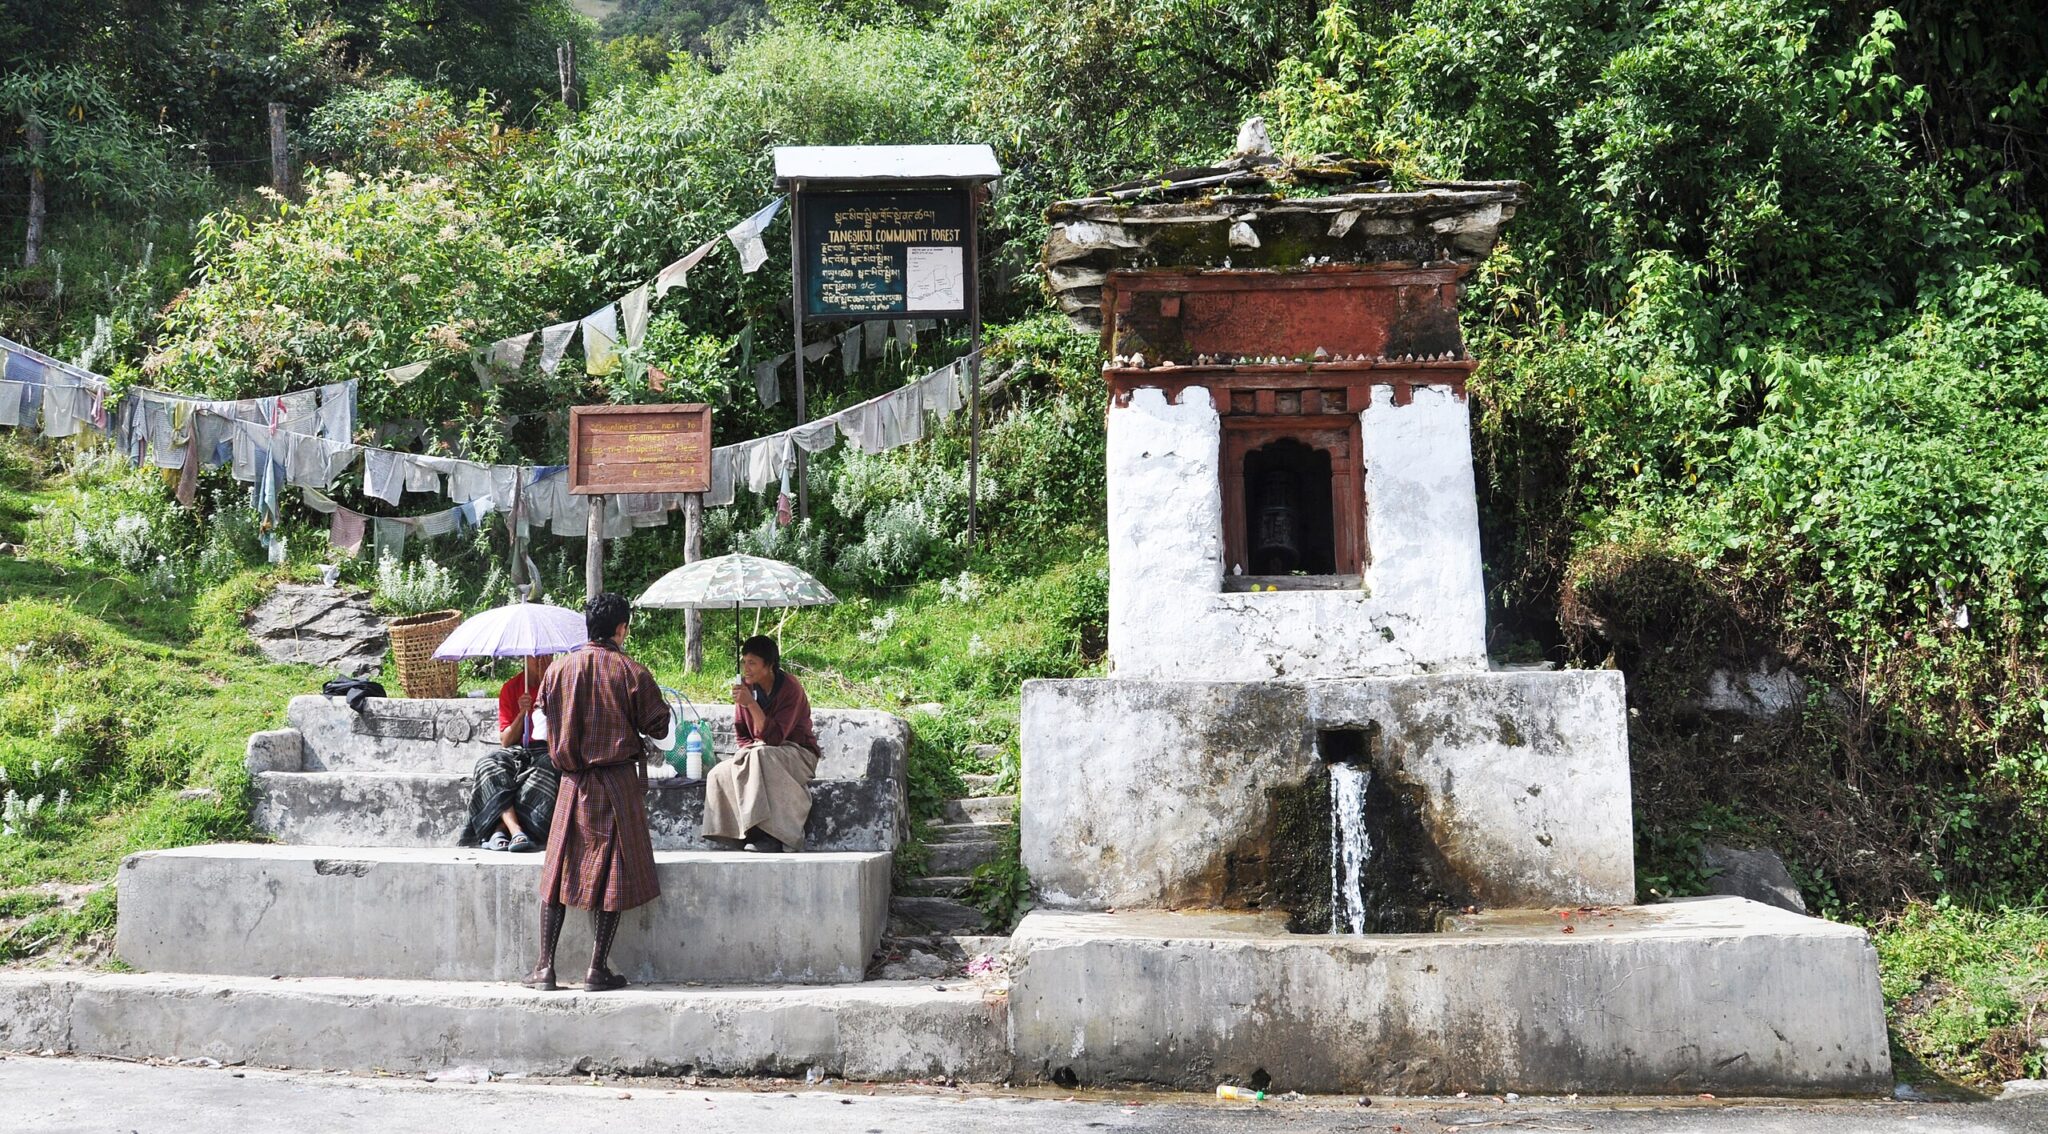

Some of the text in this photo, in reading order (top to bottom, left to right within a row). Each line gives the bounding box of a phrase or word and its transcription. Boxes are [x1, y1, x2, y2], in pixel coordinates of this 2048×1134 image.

[828, 229, 961, 243] TANGSIBJI COMMUNITY FOREST
[662, 422, 680, 430] next
[687, 422, 696, 430] to
